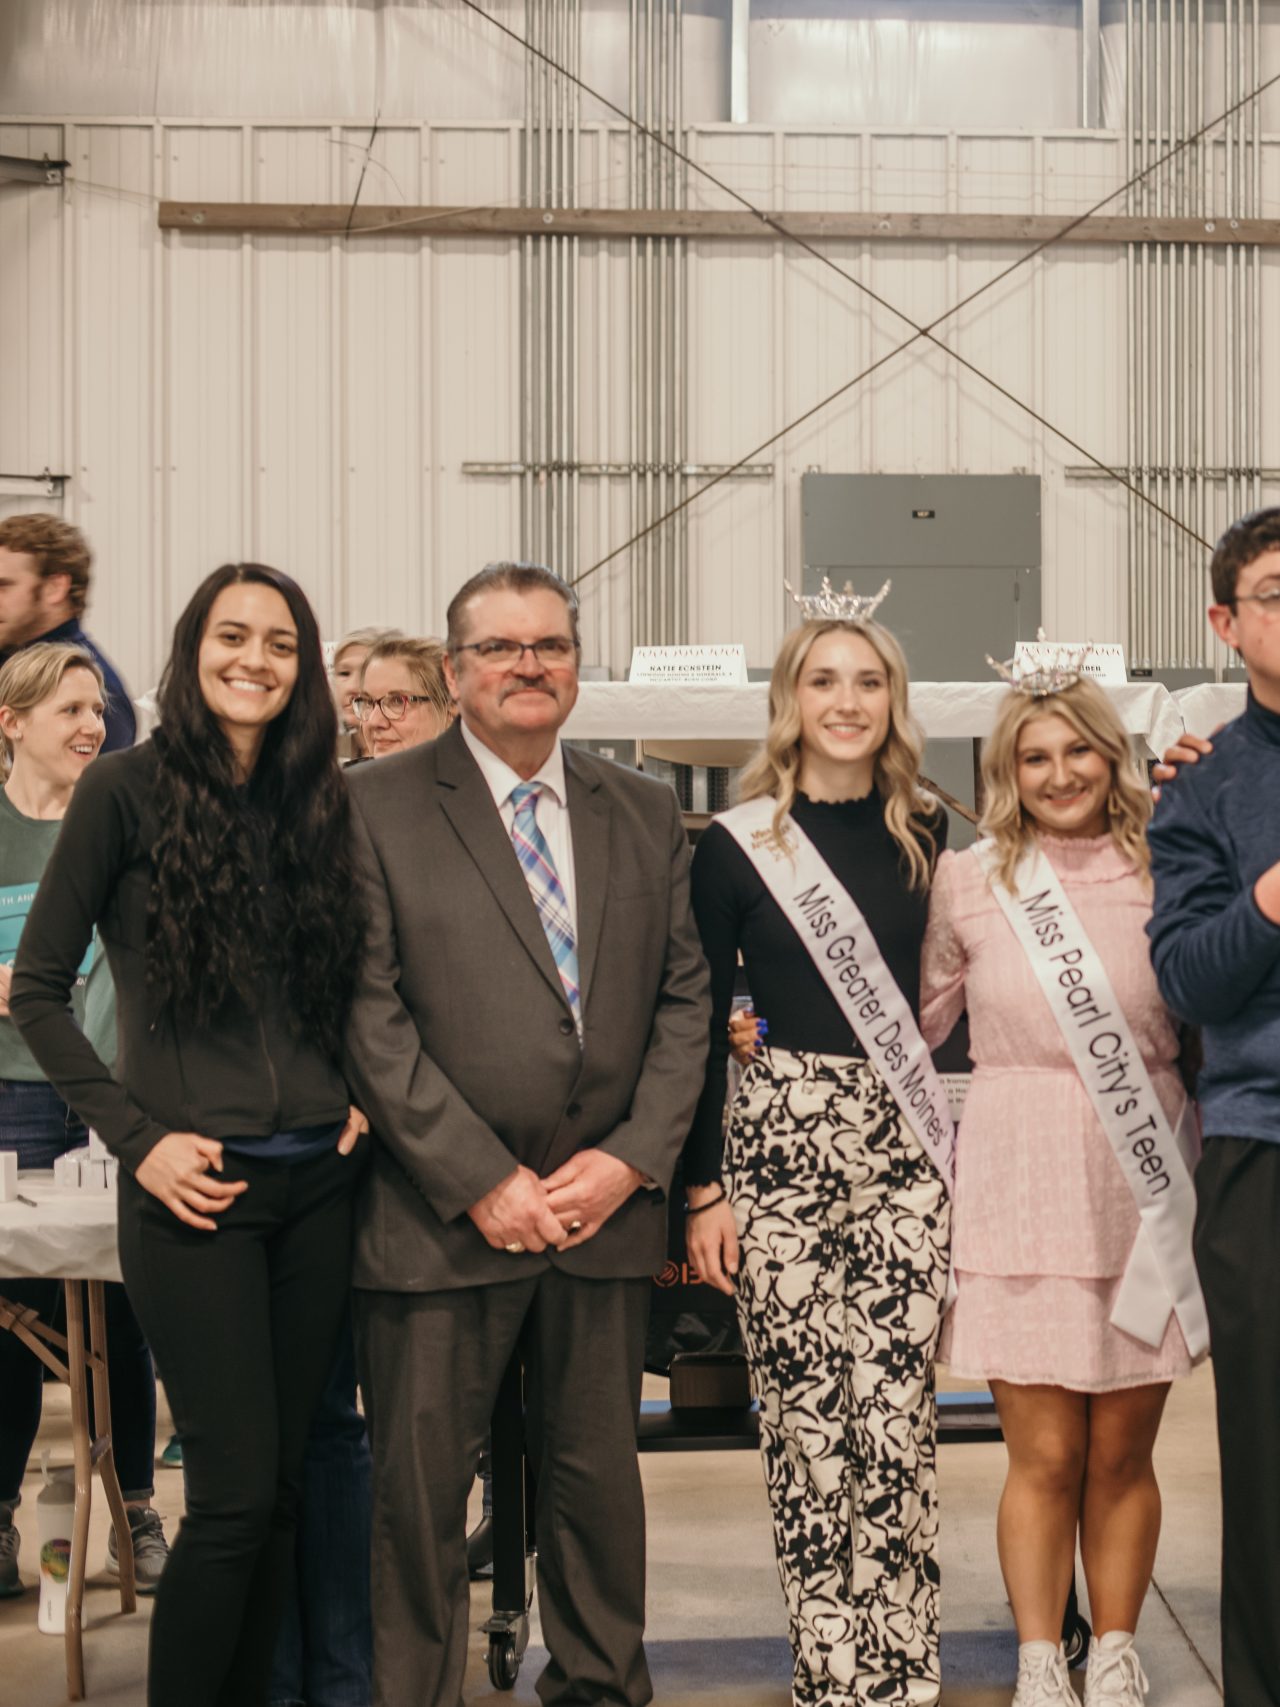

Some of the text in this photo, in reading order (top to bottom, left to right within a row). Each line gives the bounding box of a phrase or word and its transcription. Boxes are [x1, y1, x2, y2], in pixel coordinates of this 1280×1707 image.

[793, 883, 837, 938] Miss
[826, 935, 887, 1026] Greater
[874, 1020, 909, 1072] Des
[1020, 889, 1171, 1195] Miss Pearl City's Teen
